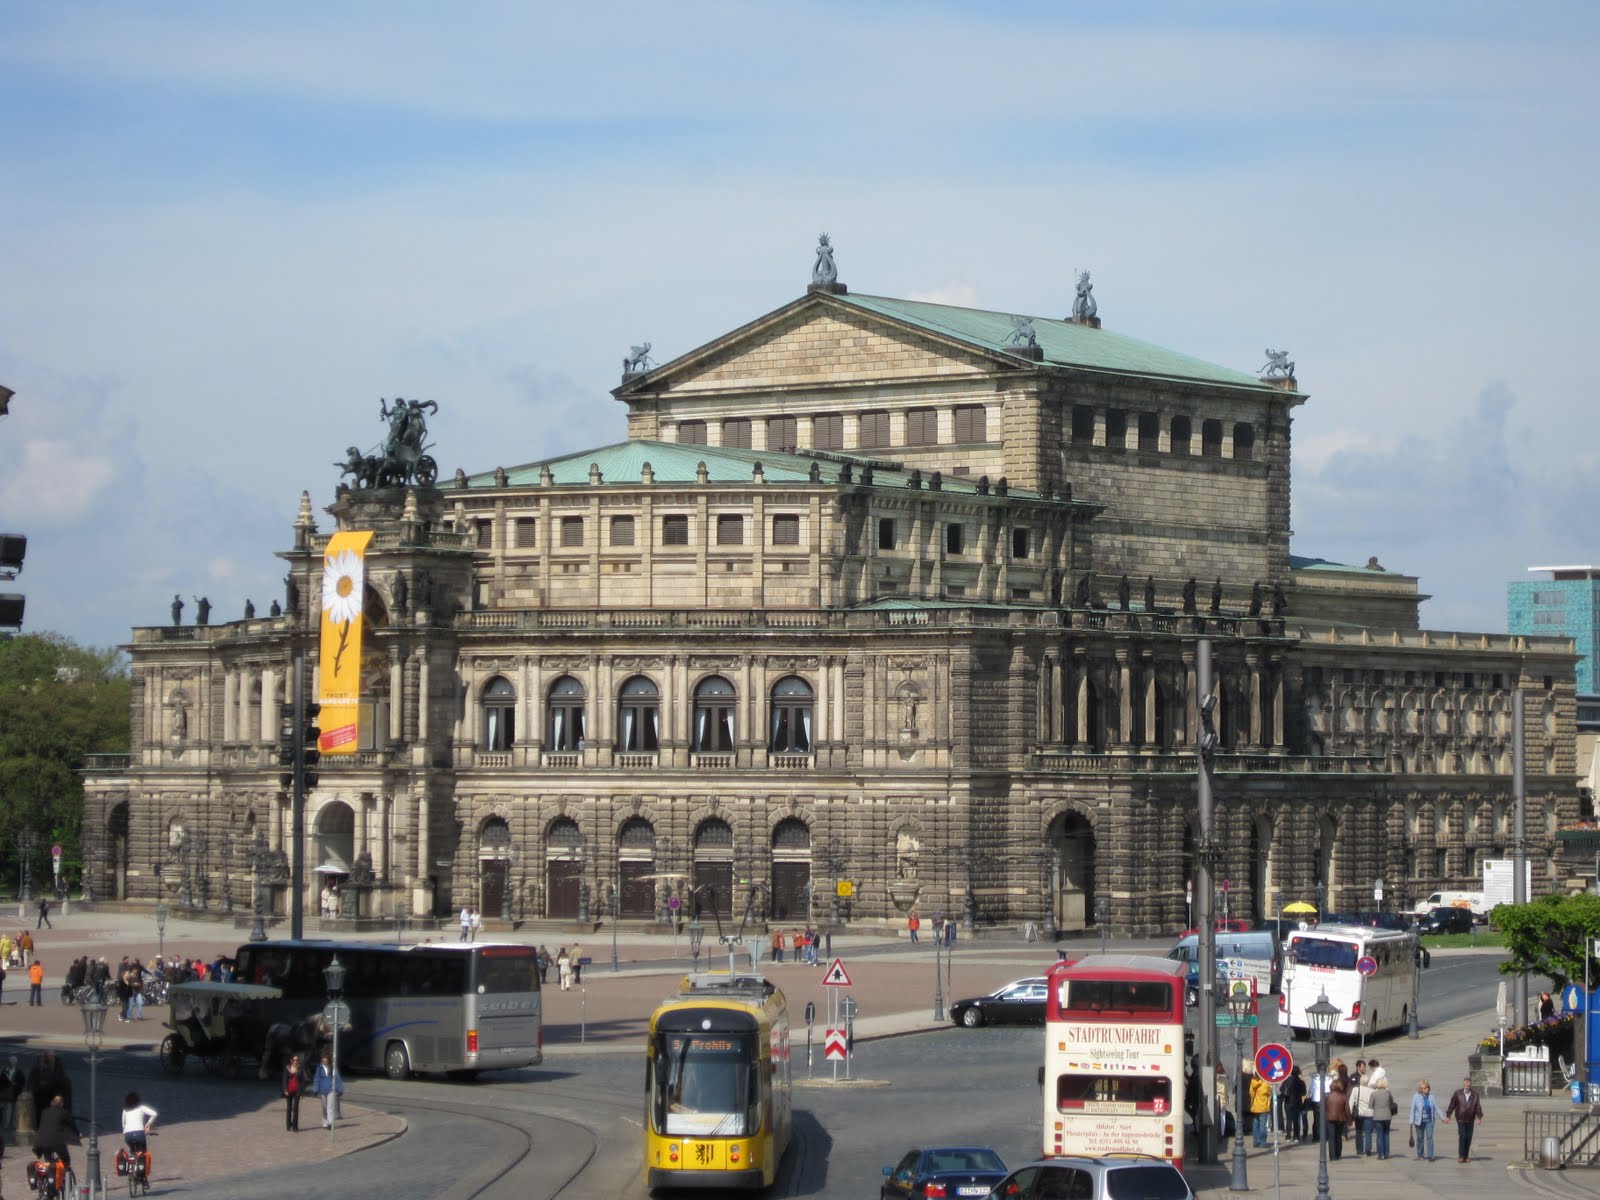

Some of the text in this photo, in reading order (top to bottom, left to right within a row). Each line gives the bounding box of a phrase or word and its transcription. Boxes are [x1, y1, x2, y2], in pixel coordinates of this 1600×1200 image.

[1068, 1027, 1162, 1045] STADTRUNDFAHRT
[692, 1039, 732, 1050] Prohlis
[1089, 1048, 1140, 1061] Sightseeing Tour
